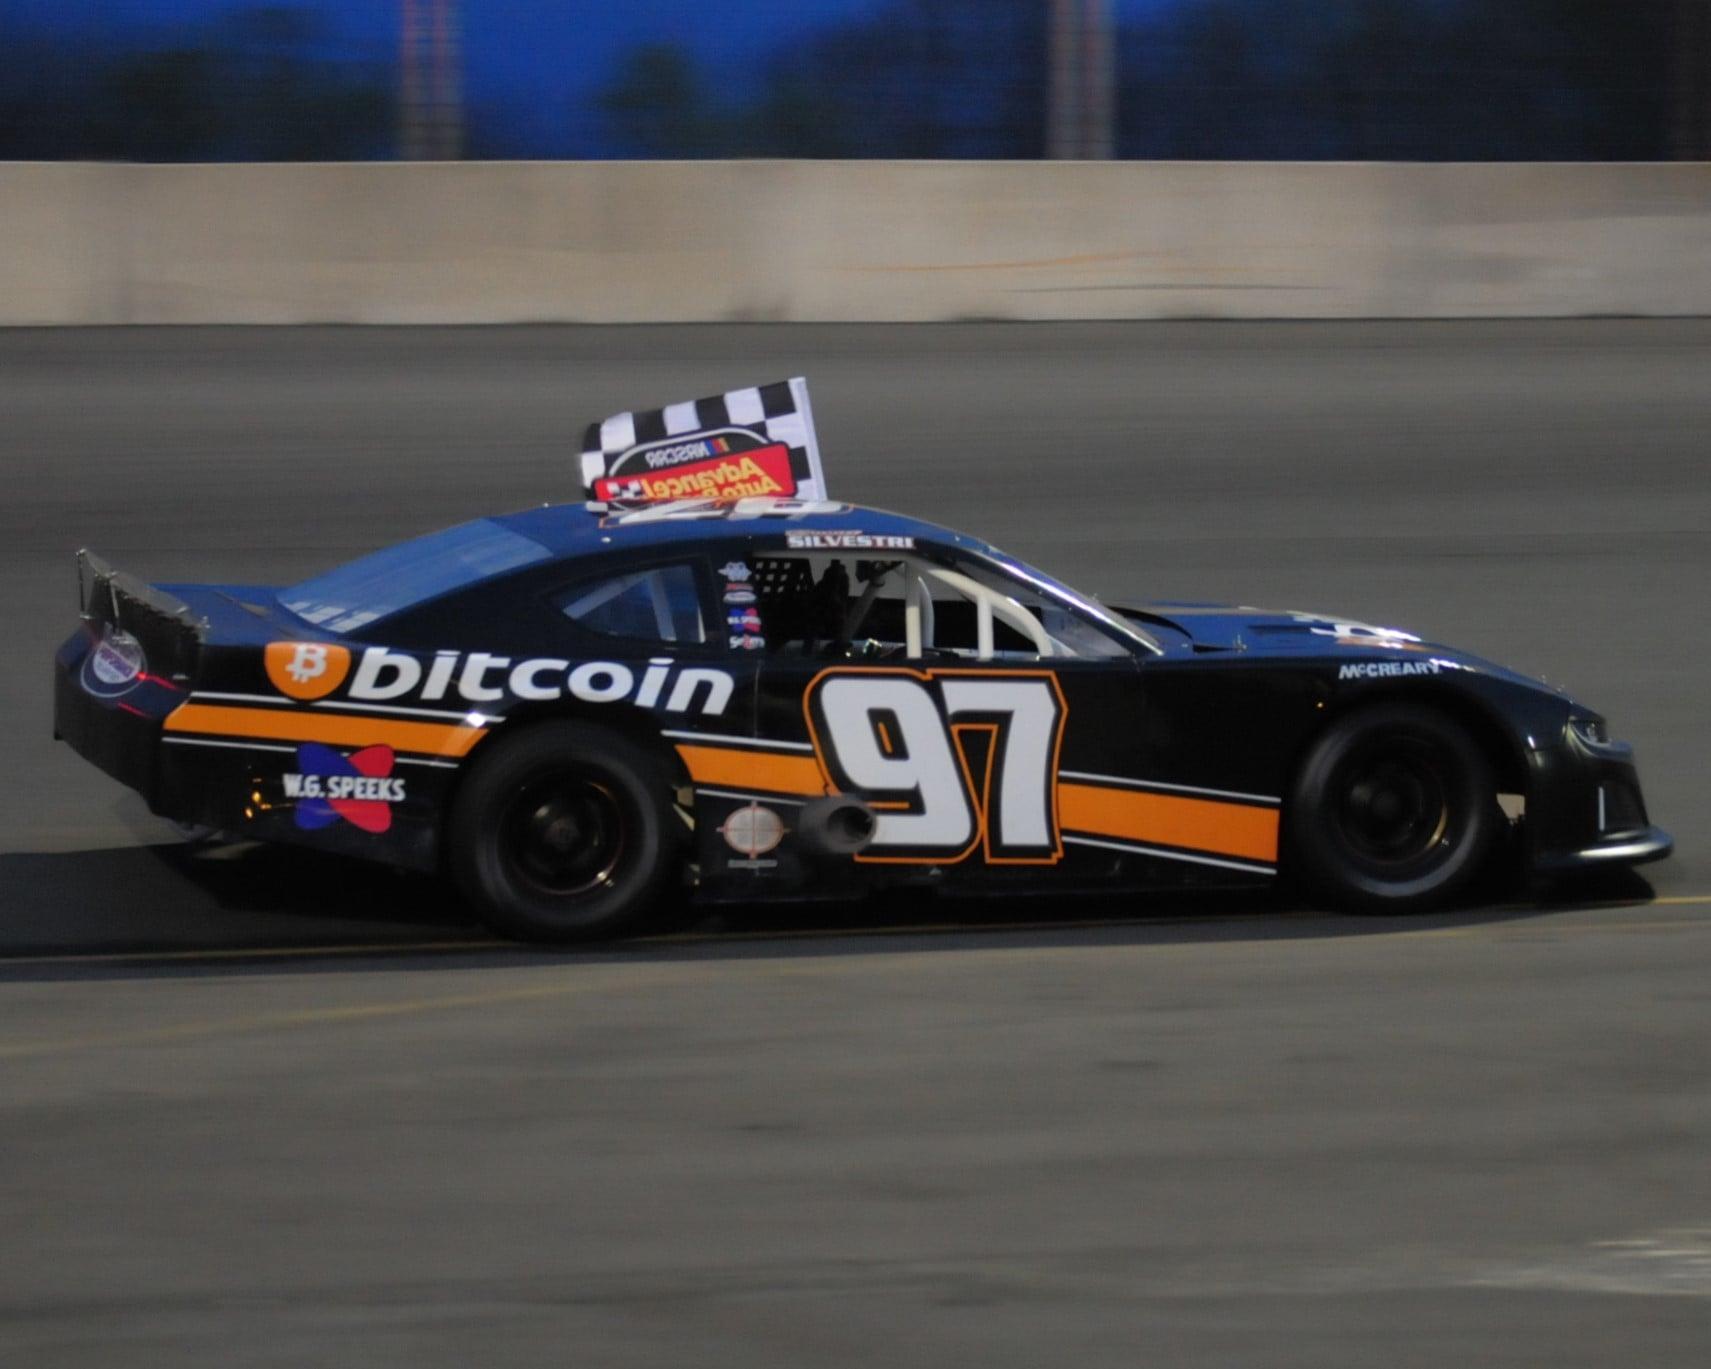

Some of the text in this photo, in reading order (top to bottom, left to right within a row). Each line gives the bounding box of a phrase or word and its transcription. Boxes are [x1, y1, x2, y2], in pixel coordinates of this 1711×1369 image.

[787, 534, 916, 549] SILVESTRI
[347, 646, 735, 716] bitcoin
[820, 677, 1057, 846] 97
[283, 773, 405, 801] W.G. SPEEKS
